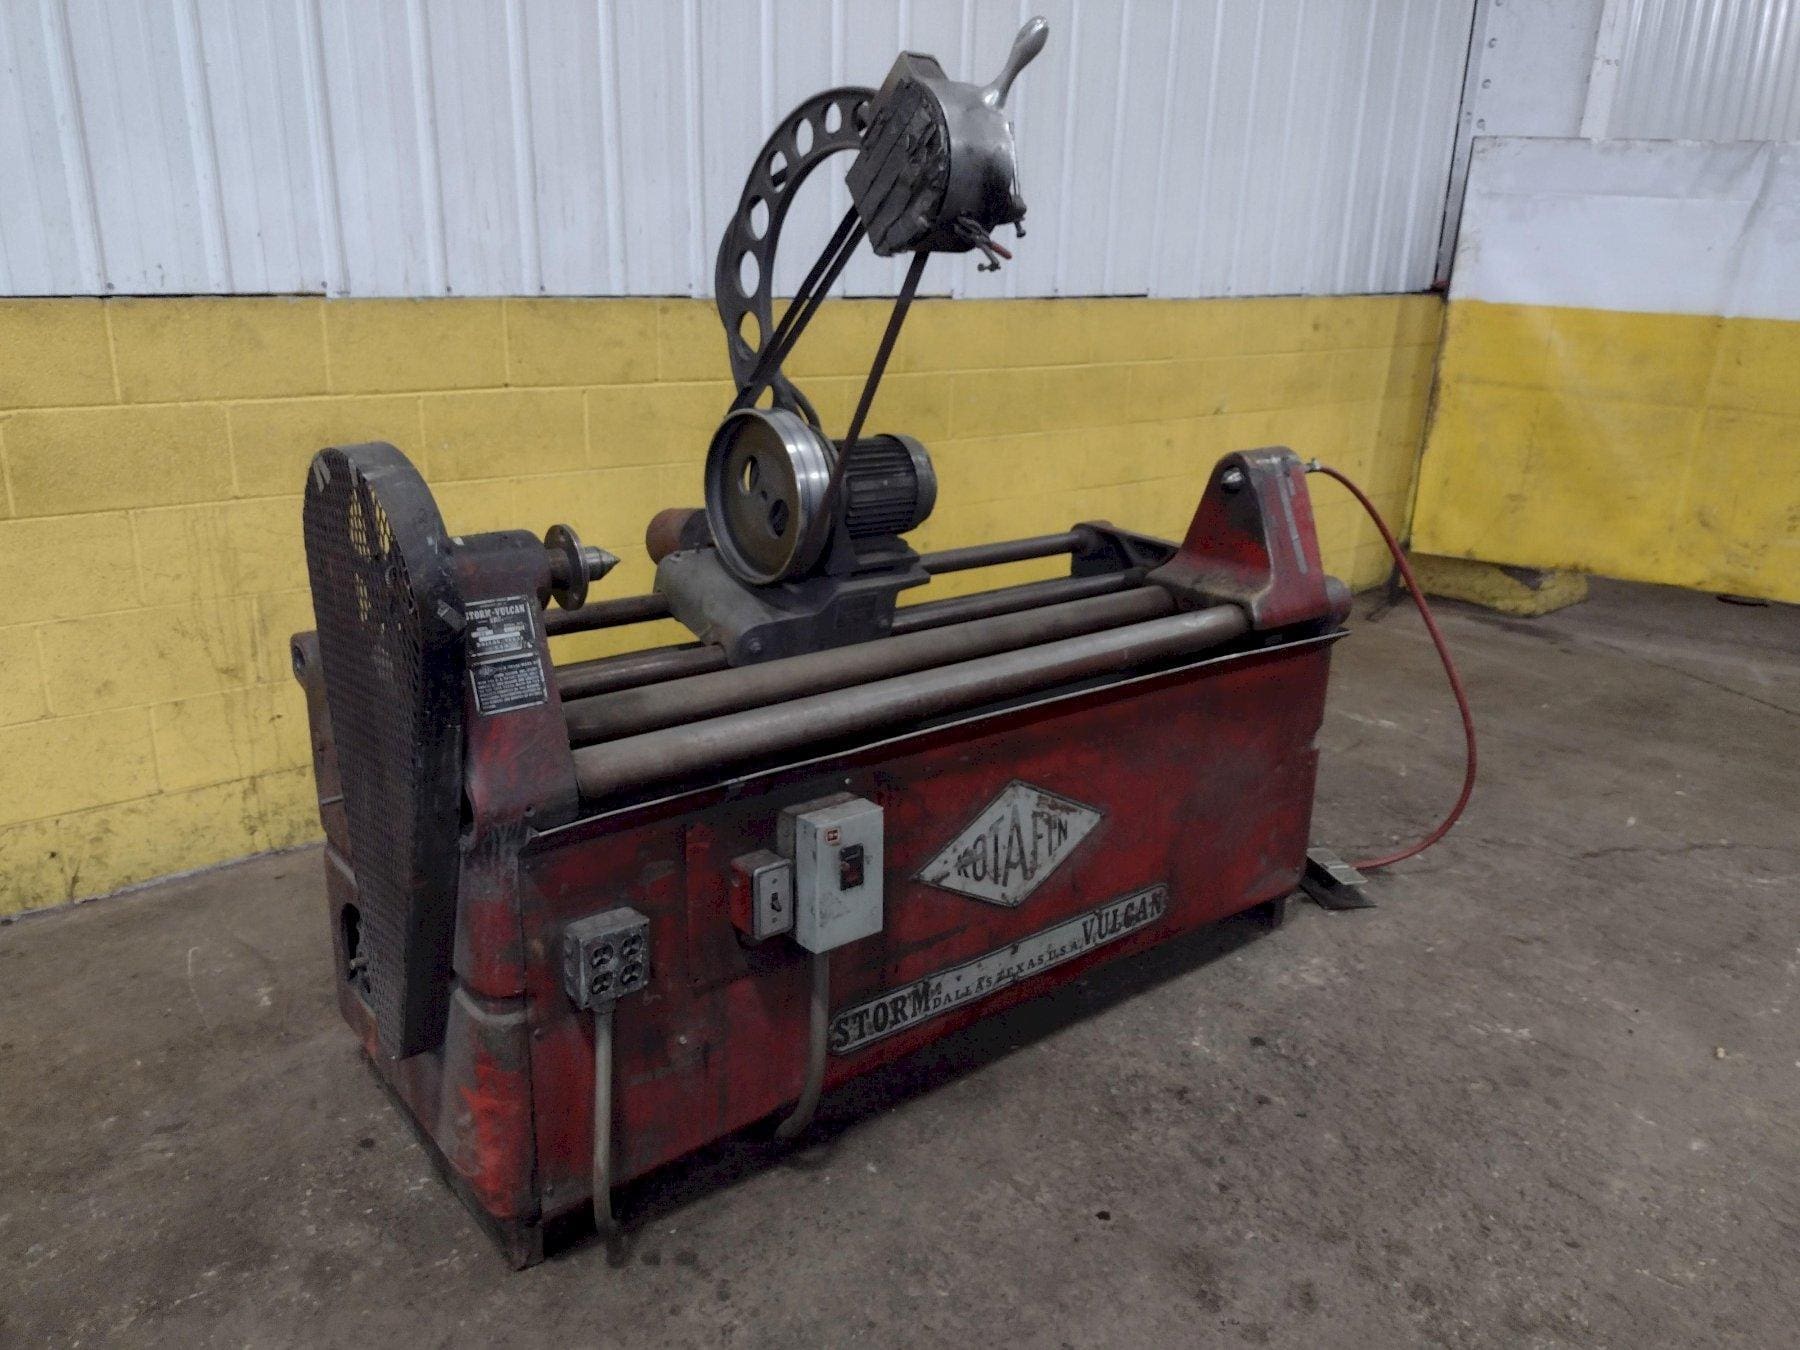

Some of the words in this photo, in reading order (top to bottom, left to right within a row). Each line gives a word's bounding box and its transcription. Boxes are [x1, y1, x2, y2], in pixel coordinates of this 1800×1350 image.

[832, 979, 932, 1049] STORM
[932, 976, 993, 1010] DALLAS
[1081, 890, 1164, 946] VULCAN
